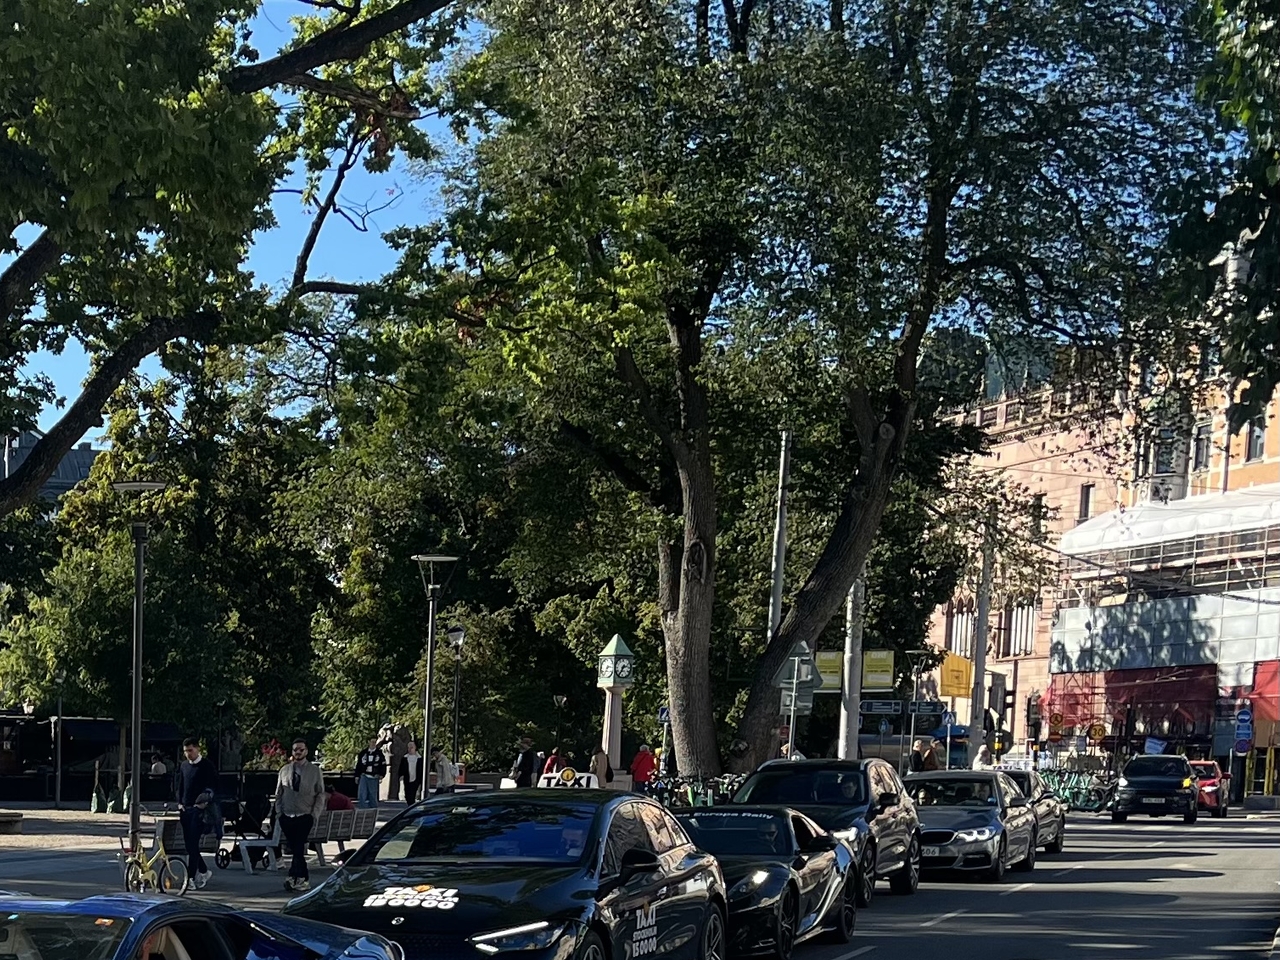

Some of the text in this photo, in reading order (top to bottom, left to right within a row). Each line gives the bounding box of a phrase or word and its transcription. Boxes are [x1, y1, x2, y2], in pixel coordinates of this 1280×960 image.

[1092, 728, 1104, 737] 30
[543, 775, 592, 788] TAXI
[741, 812, 774, 820] Rally
[384, 886, 459, 897] TAXI
[636, 906, 656, 929] TAXI
